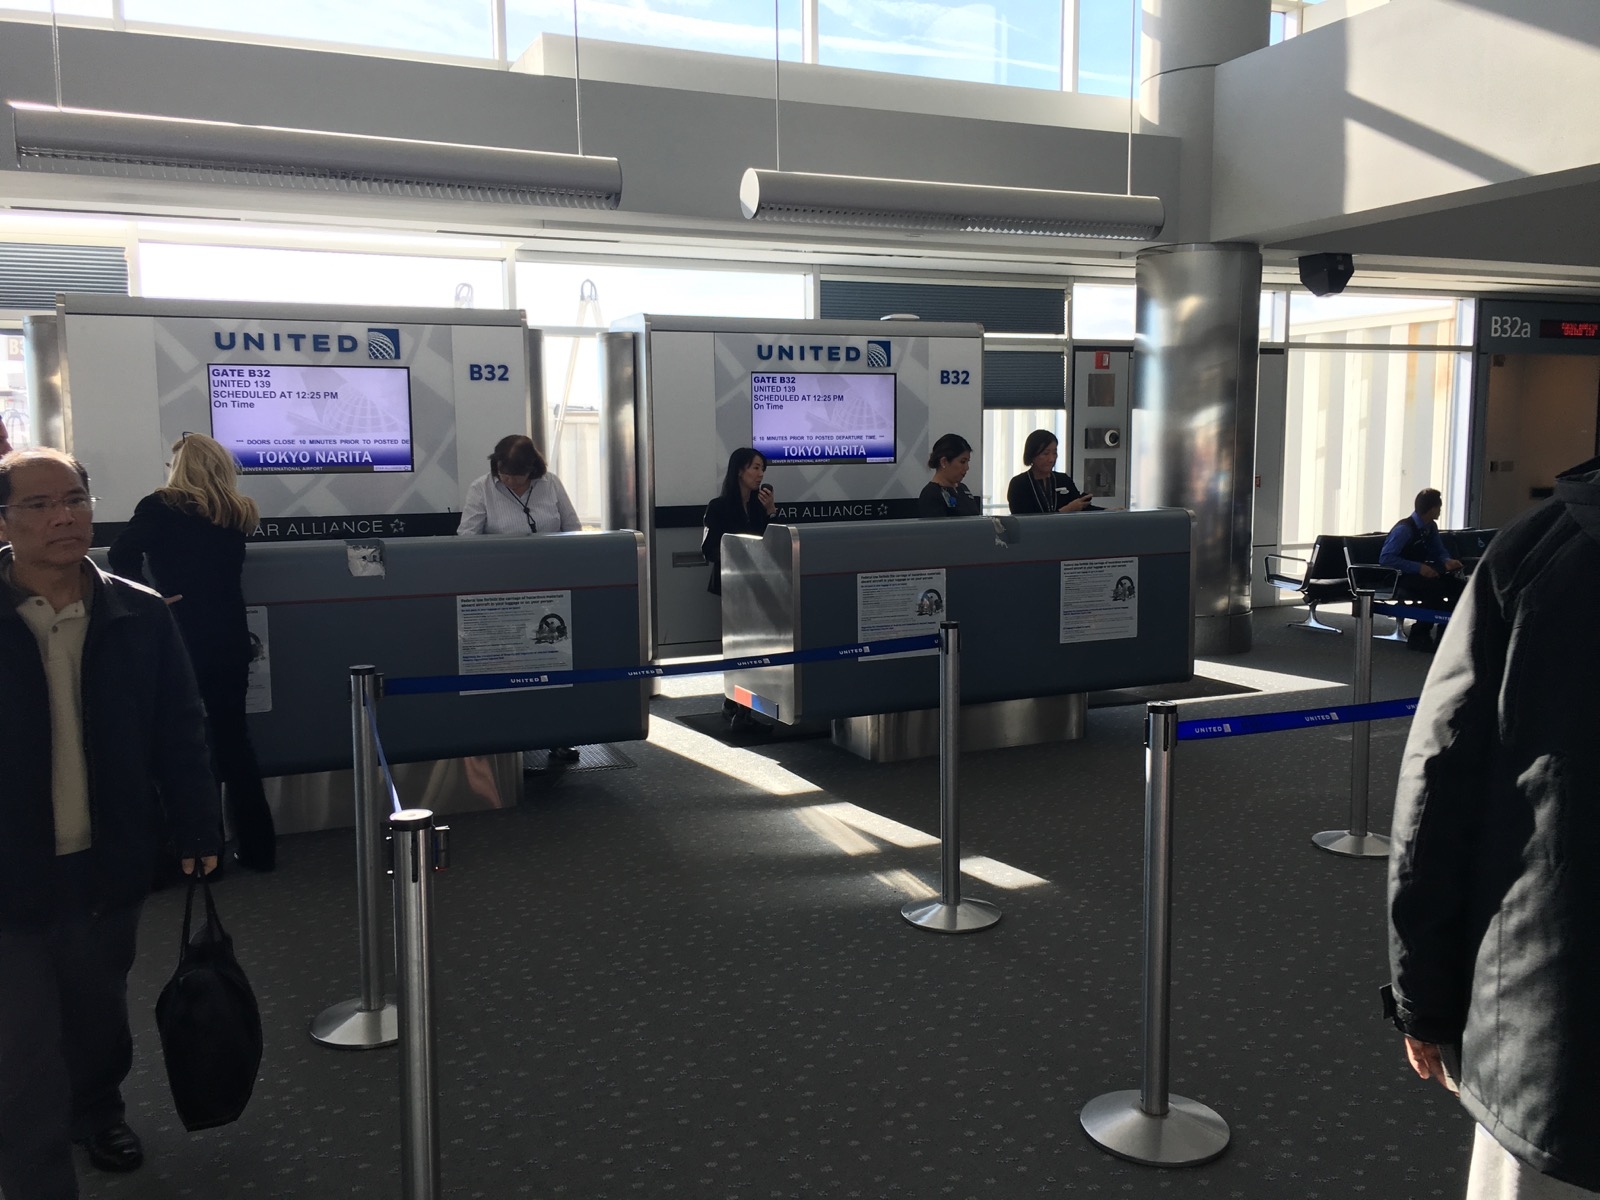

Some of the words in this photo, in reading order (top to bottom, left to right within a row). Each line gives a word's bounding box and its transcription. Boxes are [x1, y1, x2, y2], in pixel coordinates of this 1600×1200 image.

[1490, 315, 1531, 338] B32a
[214, 331, 358, 353] UNITED
[757, 344, 861, 362] UNITED
[211, 368, 245, 378] GATE
[248, 369, 271, 378] B32
[469, 363, 510, 382] B32
[940, 369, 970, 385] B32
[212, 379, 251, 388] UNITED
[254, 380, 271, 388] 139
[753, 376, 778, 384] GATE
[779, 376, 796, 384] B32
[753, 385, 782, 393] UNITED
[784, 385, 796, 393] 139
[212, 390, 277, 399] SCHEDULED
[279, 390, 293, 399] AT
[295, 391, 321, 400] 12:25
[323, 391, 339, 400] PM
[753, 394, 800, 402] SCHEDULED
[801, 394, 811, 402] AT
[813, 394, 832, 402] 12:25
[833, 394, 844, 402] PM
[213, 400, 228, 408] On
[231, 400, 255, 409] Time
[766, 402, 784, 410] Time
[782, 445, 822, 457] TOKYO
[824, 445, 867, 456] NARITA
[256, 450, 311, 464] TOKYO
[315, 450, 373, 463] NARITA
[802, 504, 873, 518] ALLIANCE
[246, 522, 280, 537] AR
[286, 520, 383, 536] ALLIANCE
[838, 647, 863, 655] UNITED
[627, 669, 656, 677] UNITED
[510, 676, 540, 684] UNITED
[1304, 713, 1331, 722] UNITED
[1194, 725, 1223, 734] UNITED
